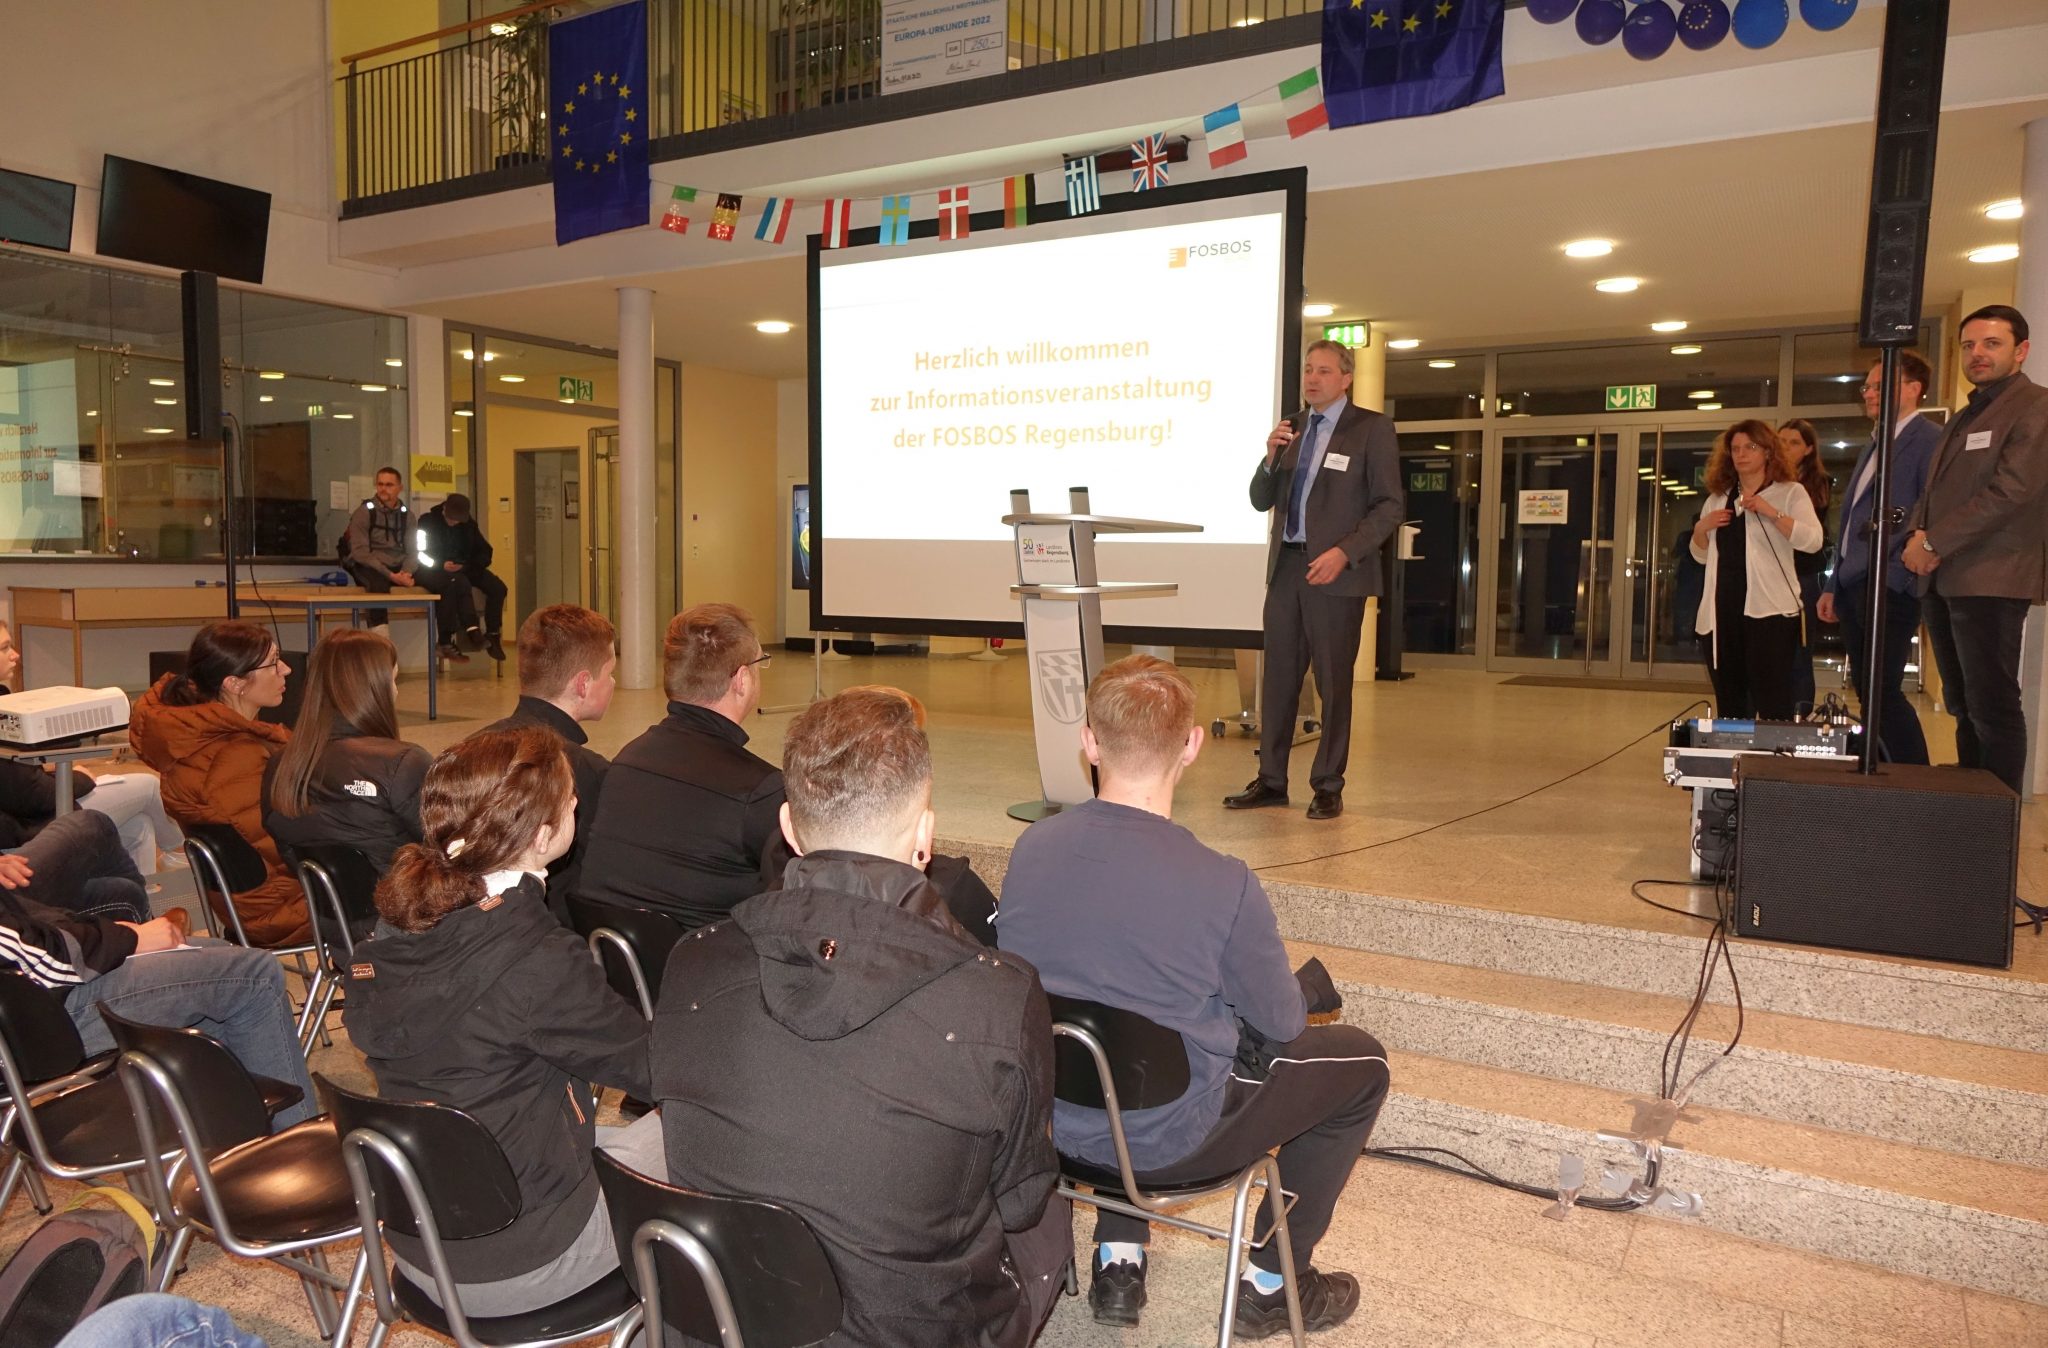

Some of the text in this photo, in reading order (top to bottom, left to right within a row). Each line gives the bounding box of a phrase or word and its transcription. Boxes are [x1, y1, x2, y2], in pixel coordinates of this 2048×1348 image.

[894, 15, 991, 42] EUROPA-URKUNDE 2022
[1189, 240, 1252, 258] FOSBOS
[914, 337, 1151, 371] Herzlich willkommen
[870, 376, 1213, 412] zur Informationsveranstaltung
[893, 419, 1173, 450] der FOSBOS Regensburg!
[1023, 538, 1034, 549] 50
